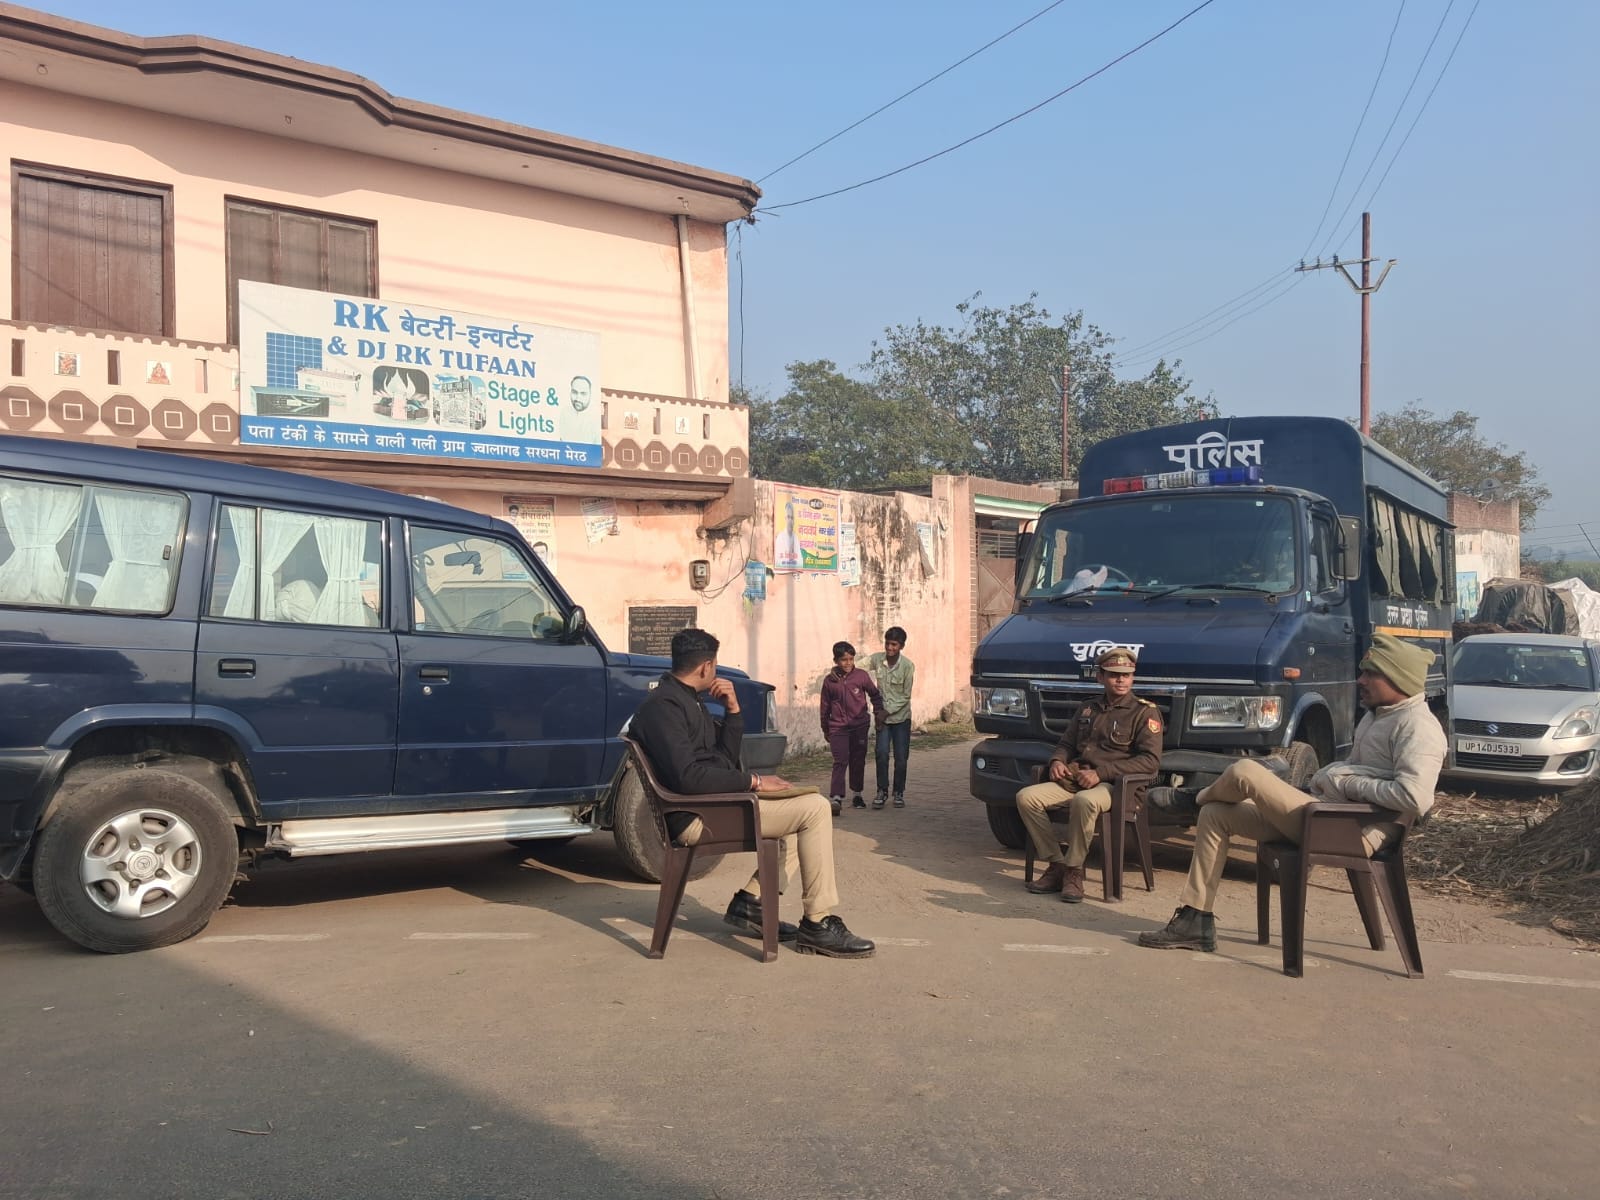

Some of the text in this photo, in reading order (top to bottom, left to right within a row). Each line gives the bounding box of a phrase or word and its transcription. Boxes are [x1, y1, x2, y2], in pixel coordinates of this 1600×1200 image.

[333, 299, 390, 333] RK
[328, 336, 536, 378] & DJ RK TUFAAN
[488, 381, 559, 408] Stage &
[499, 410, 555, 435] Lights
[248, 425, 274, 439] पता
[314, 425, 326, 443] के
[332, 429, 369, 446] सामने
[376, 433, 405, 449] वाली
[411, 435, 437, 451] गली
[442, 440, 465, 453] ग्राम
[565, 446, 587, 462] मेरठ
[1162, 431, 1264, 470] पलिस
